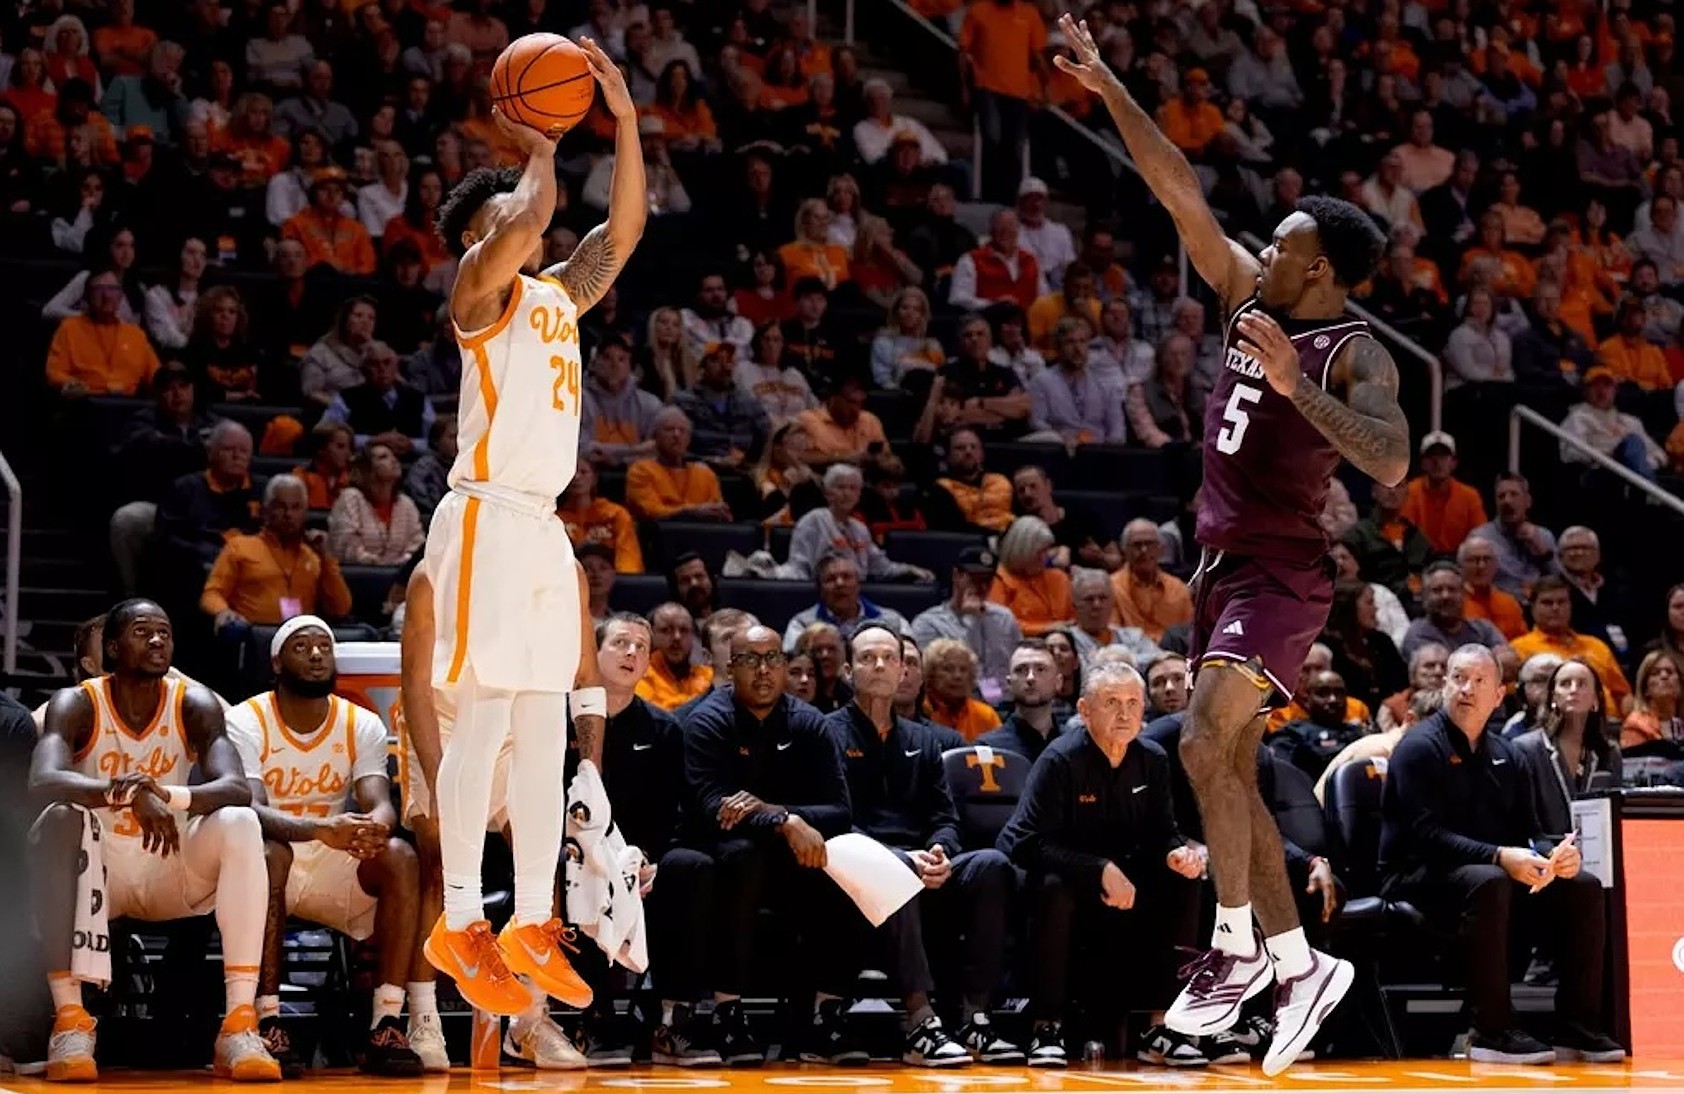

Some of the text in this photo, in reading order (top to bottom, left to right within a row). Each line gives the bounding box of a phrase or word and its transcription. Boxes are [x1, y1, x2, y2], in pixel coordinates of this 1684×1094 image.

[1225, 347, 1265, 379] TEXAS
[550, 354, 579, 417] 24
[1216, 382, 1263, 455] 5
[264, 763, 349, 798] Vols
[965, 754, 1006, 792] T
